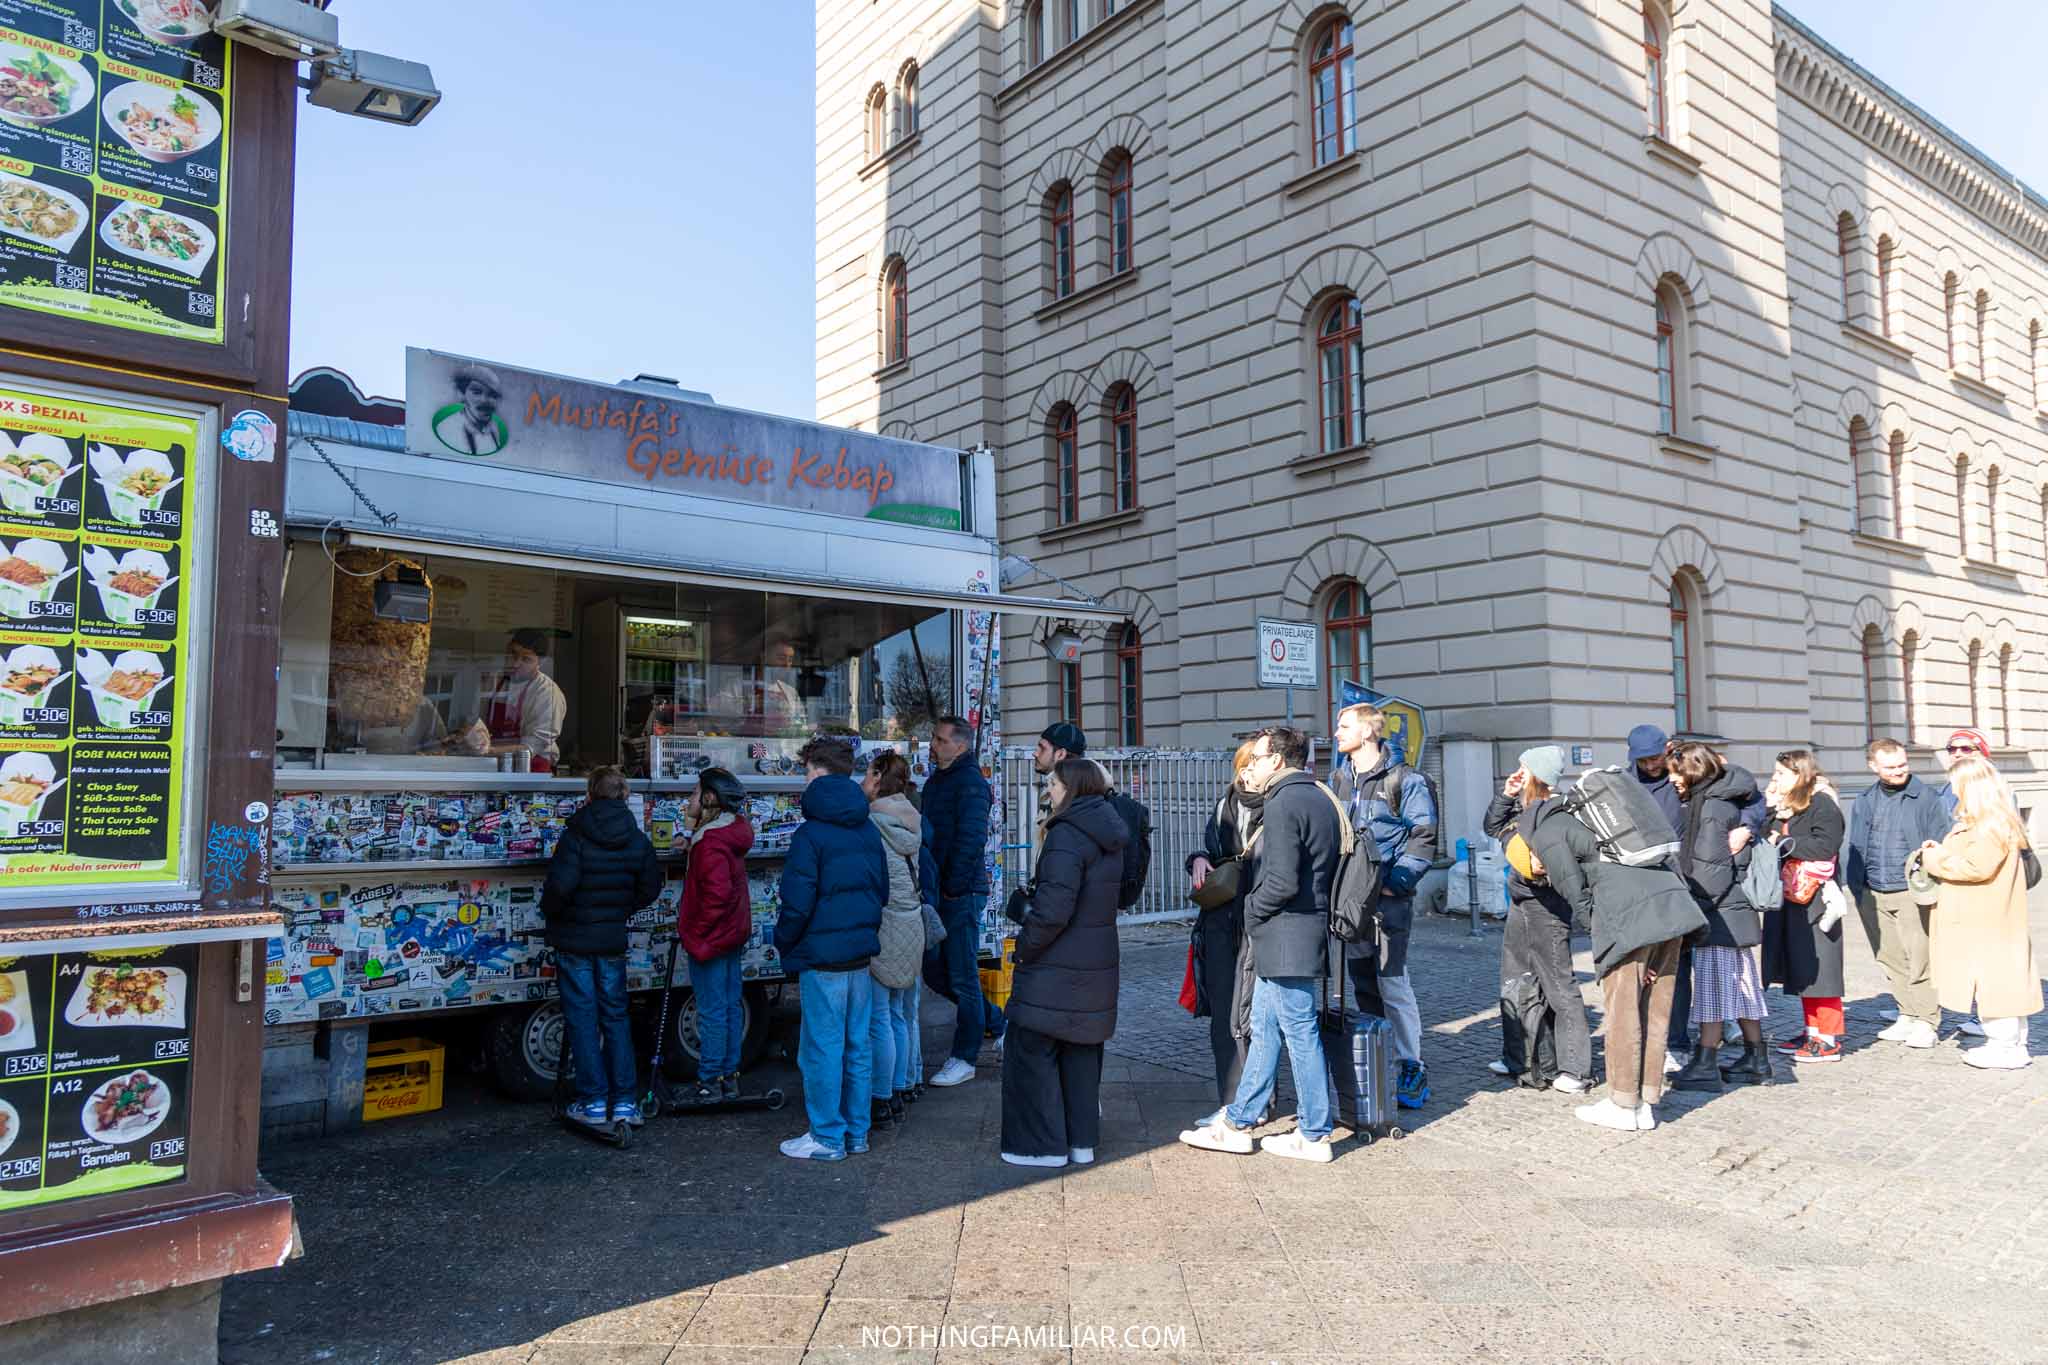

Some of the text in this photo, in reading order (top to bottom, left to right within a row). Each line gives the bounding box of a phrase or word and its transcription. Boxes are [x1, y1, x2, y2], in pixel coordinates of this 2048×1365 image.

[145, 73, 178, 89] UDOL
[188, 164, 216, 180] 6.50€
[102, 184, 158, 205] PHO XAO
[5, 238, 58, 255] Glasnudeln
[58, 263, 87, 279] 6.50€
[58, 276, 87, 291] 6.90€
[20, 403, 88, 423] SPEZIAL
[523, 391, 681, 438] Mustafa's
[626, 432, 894, 504] Gemüse Kebap
[36, 498, 77, 512] 4.50€
[142, 510, 178, 524] 4.90€
[251, 510, 270, 520] SO
[251, 518, 277, 528] ULR
[251, 527, 279, 536] OCK
[31, 602, 73, 615] 6.90€
[136, 609, 174, 623] 6.90€
[26, 709, 67, 721] 4.90€
[132, 712, 169, 725] 5.50€
[106, 751, 137, 759] NACH
[140, 751, 169, 760] WAHL
[102, 766, 114, 774] mit
[87, 783, 139, 792] Chop Suey
[82, 805, 148, 813] Erdnuss Soße
[82, 815, 159, 826] Thai Curry Soße
[20, 821, 62, 835] 5.50€
[81, 827, 105, 836] Chili
[18, 864, 46, 874] oder
[50, 862, 92, 872] Nudeln
[96, 861, 142, 870] serviert!
[354, 884, 394, 904] LABELS
[60, 963, 80, 976] A4
[157, 1040, 189, 1056] 2.90€
[10, 1056, 47, 1073] 3.50€
[53, 1079, 83, 1094] A12
[153, 1141, 184, 1157] 3.90€
[81, 1150, 131, 1168] Garnelen
[2, 1158, 40, 1177] 2.90€
